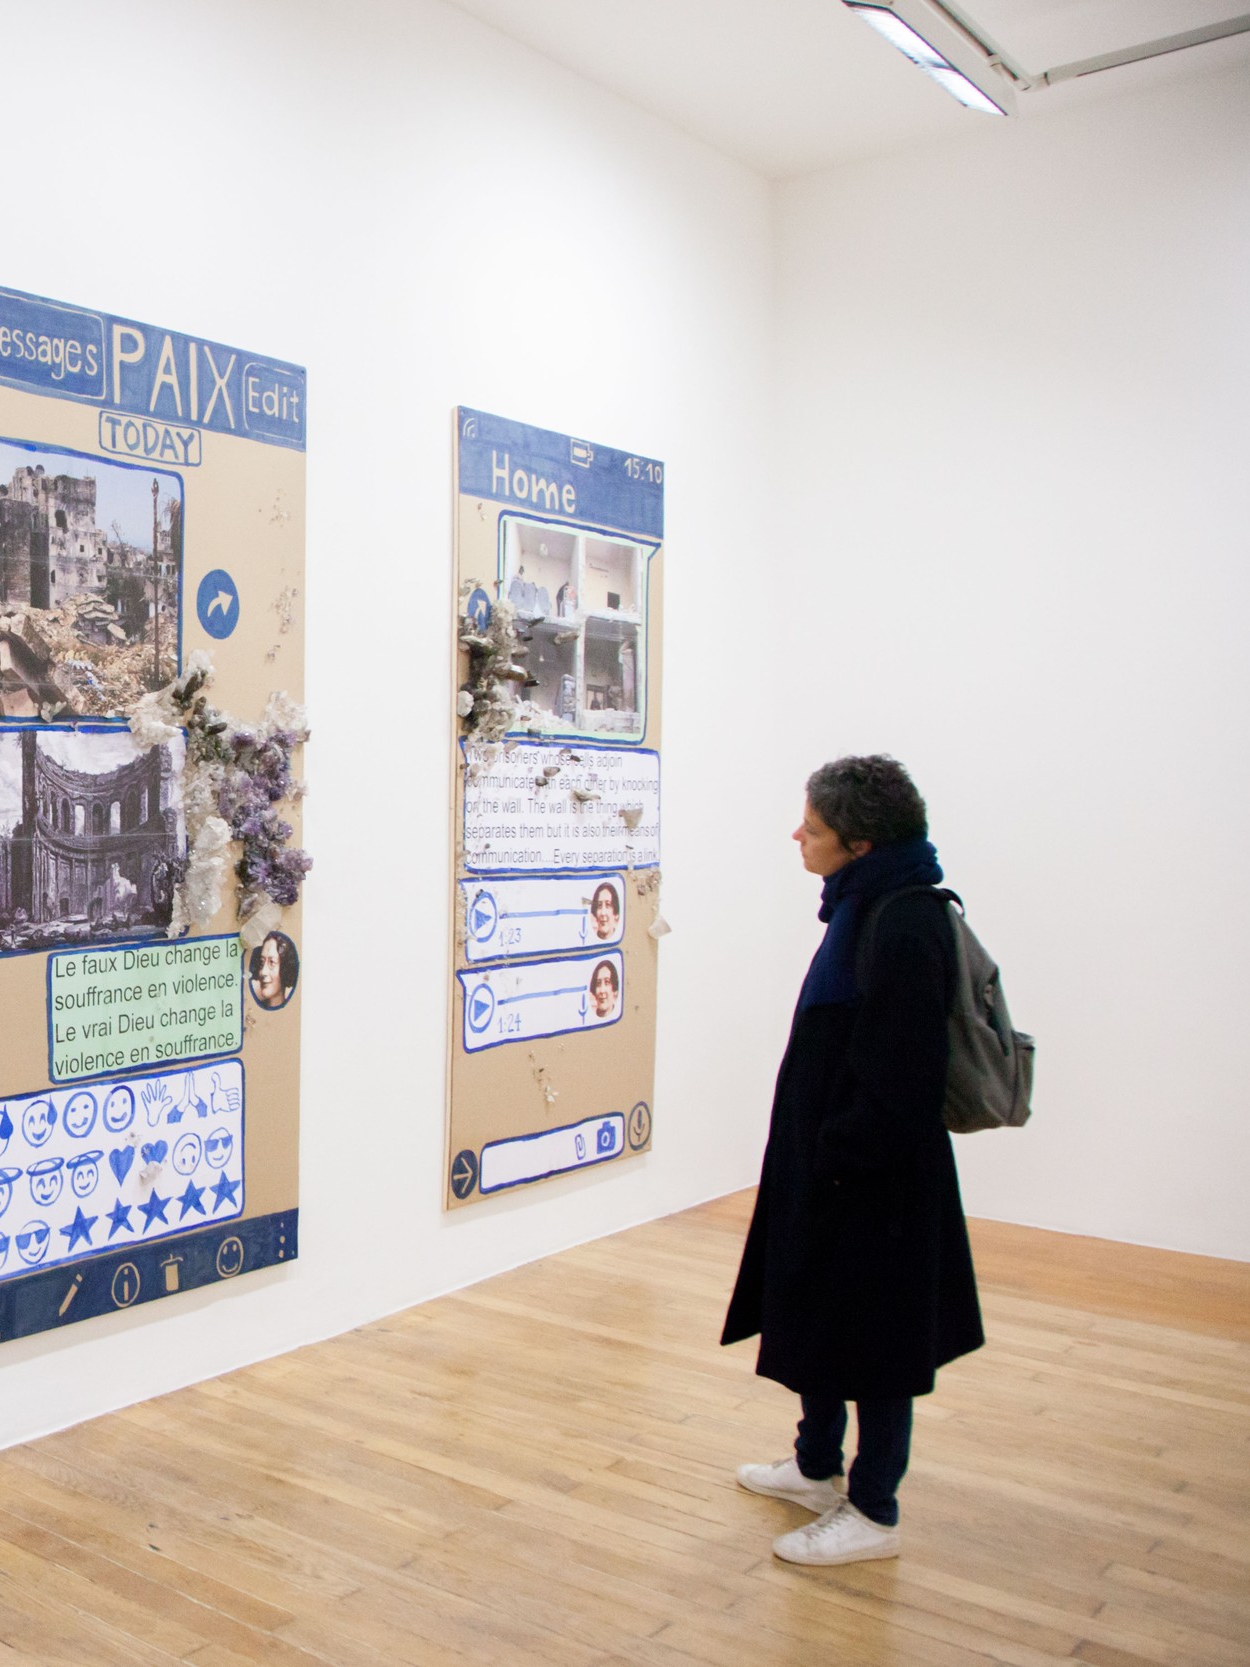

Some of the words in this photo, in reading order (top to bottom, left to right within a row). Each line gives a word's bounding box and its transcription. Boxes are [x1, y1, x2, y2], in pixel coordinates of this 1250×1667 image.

[113, 324, 236, 429] PAIX
[248, 377, 299, 423] Edit
[105, 416, 195, 464] TODAY
[492, 450, 576, 514] Home
[624, 457, 663, 484] 15:10
[541, 750, 571, 766] whose
[597, 754, 622, 771] adjoin
[559, 775, 581, 790] each
[584, 776, 607, 790] other
[609, 776, 618, 793] by
[622, 777, 660, 794] knocking
[466, 800, 478, 813] on
[483, 798, 498, 813] the
[502, 798, 524, 813] wall.
[528, 798, 546, 814] The
[549, 798, 567, 814] wall
[570, 801, 577, 814] is
[597, 800, 618, 817] thing
[466, 824, 516, 840] separates
[520, 823, 543, 838] them
[547, 822, 562, 838] but
[564, 823, 570, 838] it
[573, 823, 580, 838] is
[582, 823, 600, 838] also
[651, 822, 659, 837] of
[554, 848, 579, 866] Every
[582, 849, 627, 866] separation
[638, 851, 643, 862] a
[55, 957, 76, 978] Le
[82, 954, 118, 976] faux
[124, 949, 160, 971] Dieu
[165, 944, 221, 967] change
[226, 939, 238, 958] la
[55, 985, 142, 1011] souffrance
[148, 982, 167, 998] en
[172, 971, 238, 995] violence.
[55, 1023, 76, 1043] Le
[82, 1017, 113, 1040] vrai
[118, 1012, 155, 1033] Dieu
[160, 1006, 216, 1030] change
[221, 999, 234, 1018] la
[55, 1049, 125, 1076] violence
[130, 1044, 150, 1063] en
[155, 1030, 238, 1059] souffrance.
